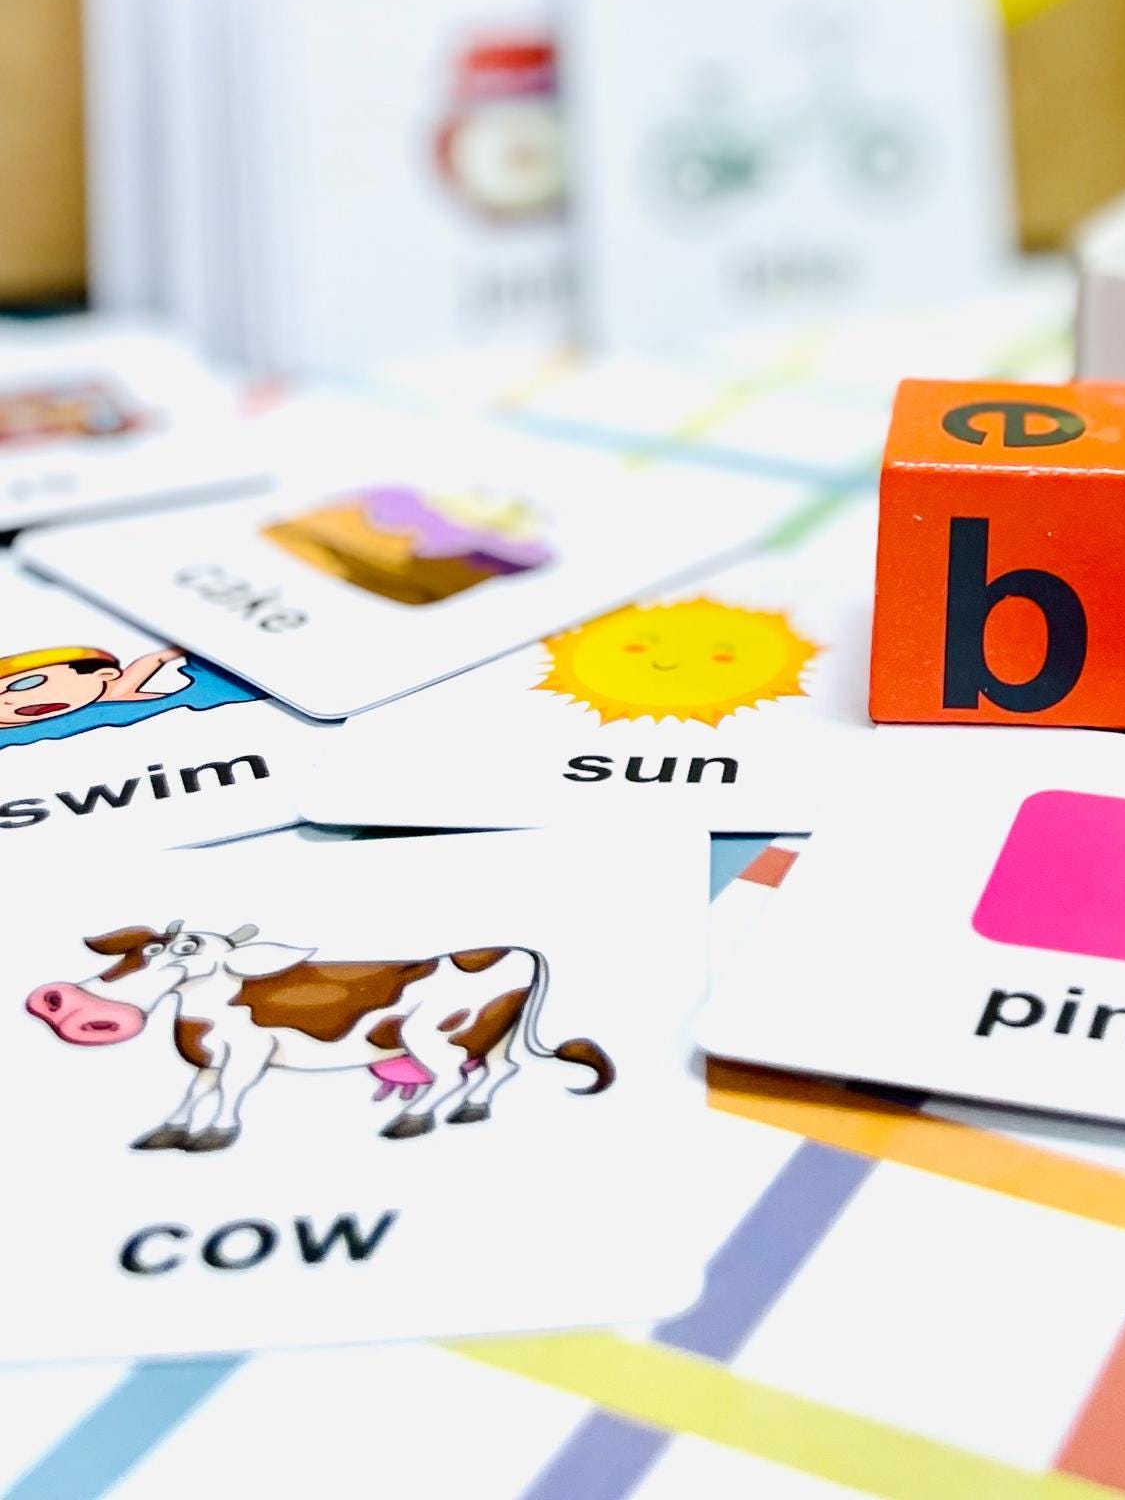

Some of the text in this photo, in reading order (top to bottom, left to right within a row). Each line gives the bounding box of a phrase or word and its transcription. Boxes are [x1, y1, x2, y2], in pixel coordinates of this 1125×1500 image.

[173, 563, 310, 633] cake
[0, 754, 270, 829] swim
[562, 754, 740, 785] sun
[117, 1211, 398, 1277] cow
